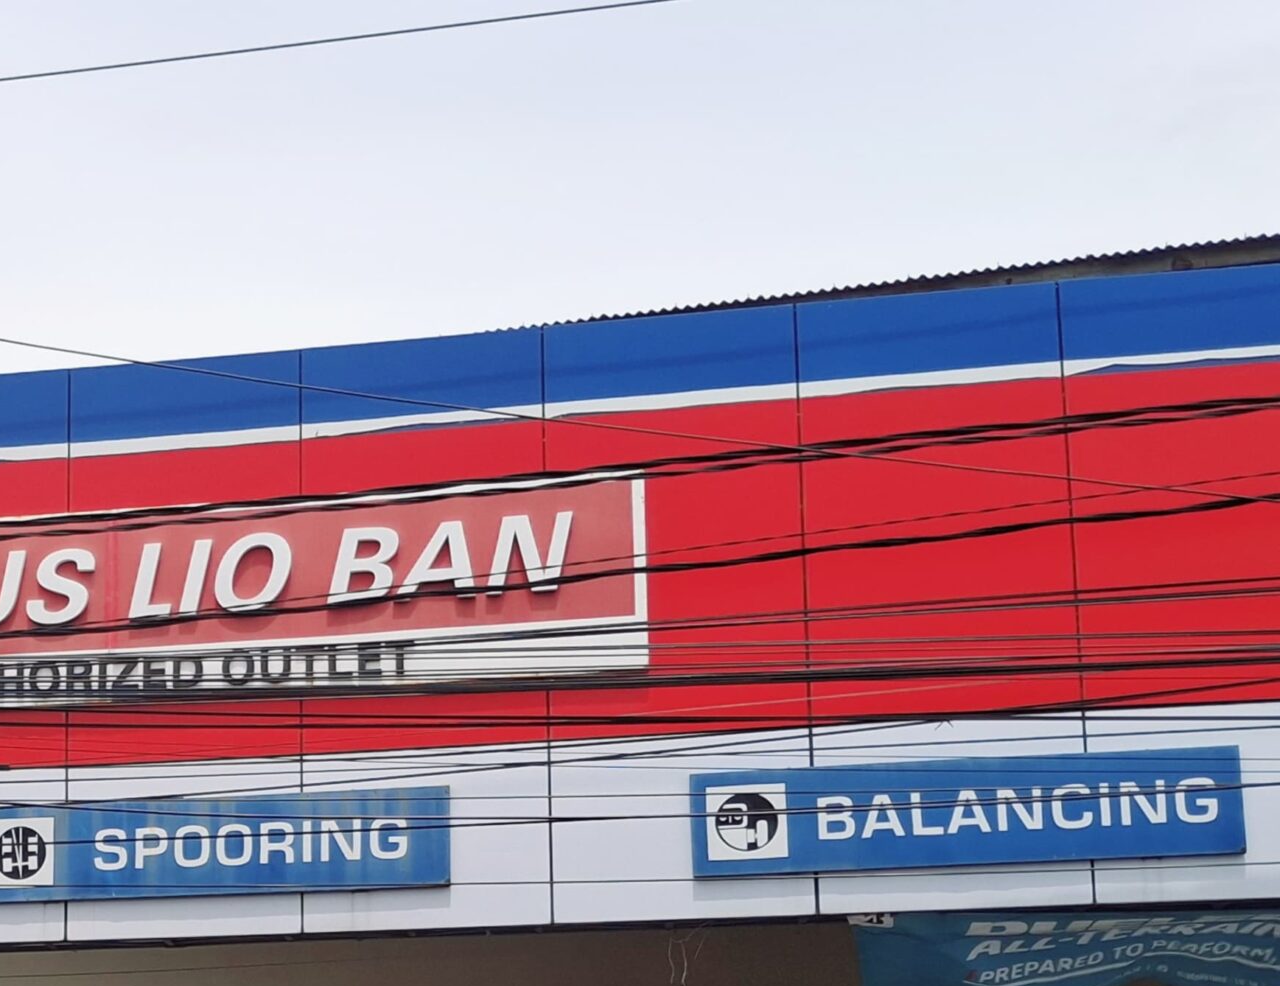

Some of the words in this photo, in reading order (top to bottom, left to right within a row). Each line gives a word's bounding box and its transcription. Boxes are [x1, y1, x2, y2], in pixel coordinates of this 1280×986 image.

[128, 532, 292, 621] LIO
[325, 511, 573, 608] BAN
[222, 640, 415, 686] OUTLET
[817, 776, 1220, 841] BALANCING
[93, 818, 408, 871] SPOORING
[979, 951, 1105, 984] PREPARED
[1113, 943, 1144, 961] TO
